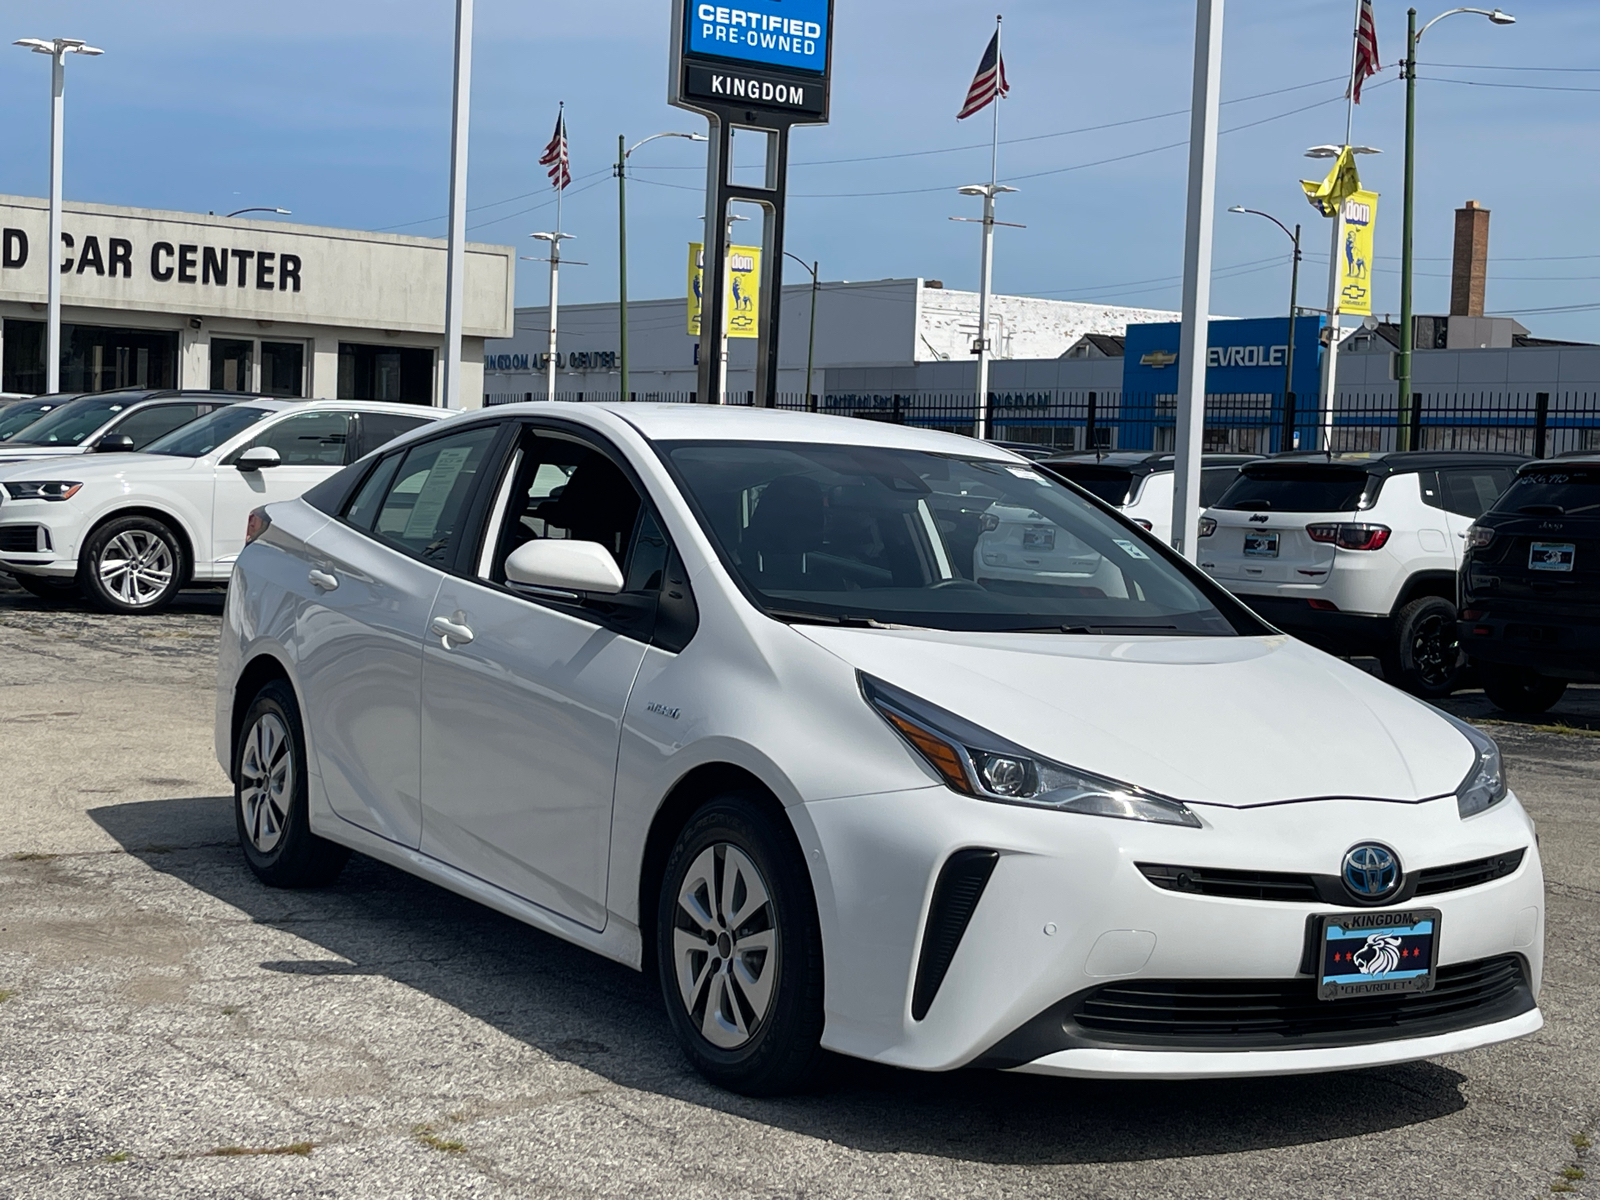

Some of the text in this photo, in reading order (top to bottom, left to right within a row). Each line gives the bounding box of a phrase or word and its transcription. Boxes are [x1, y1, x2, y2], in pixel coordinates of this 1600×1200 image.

[698, 4, 821, 39] CERTIFIED
[702, 24, 816, 55] PRE-OWNED
[711, 75, 804, 105] KINGDOM
[1345, 200, 1370, 225] dom
[60, 232, 132, 278] CAR
[150, 241, 303, 292] CENTER
[731, 253, 754, 272] dom
[484, 354, 529, 370] INGDOM
[569, 351, 616, 369] CENTER
[1351, 913, 1413, 928] KINGDOM
[1344, 981, 1407, 995] CHEVROLET
